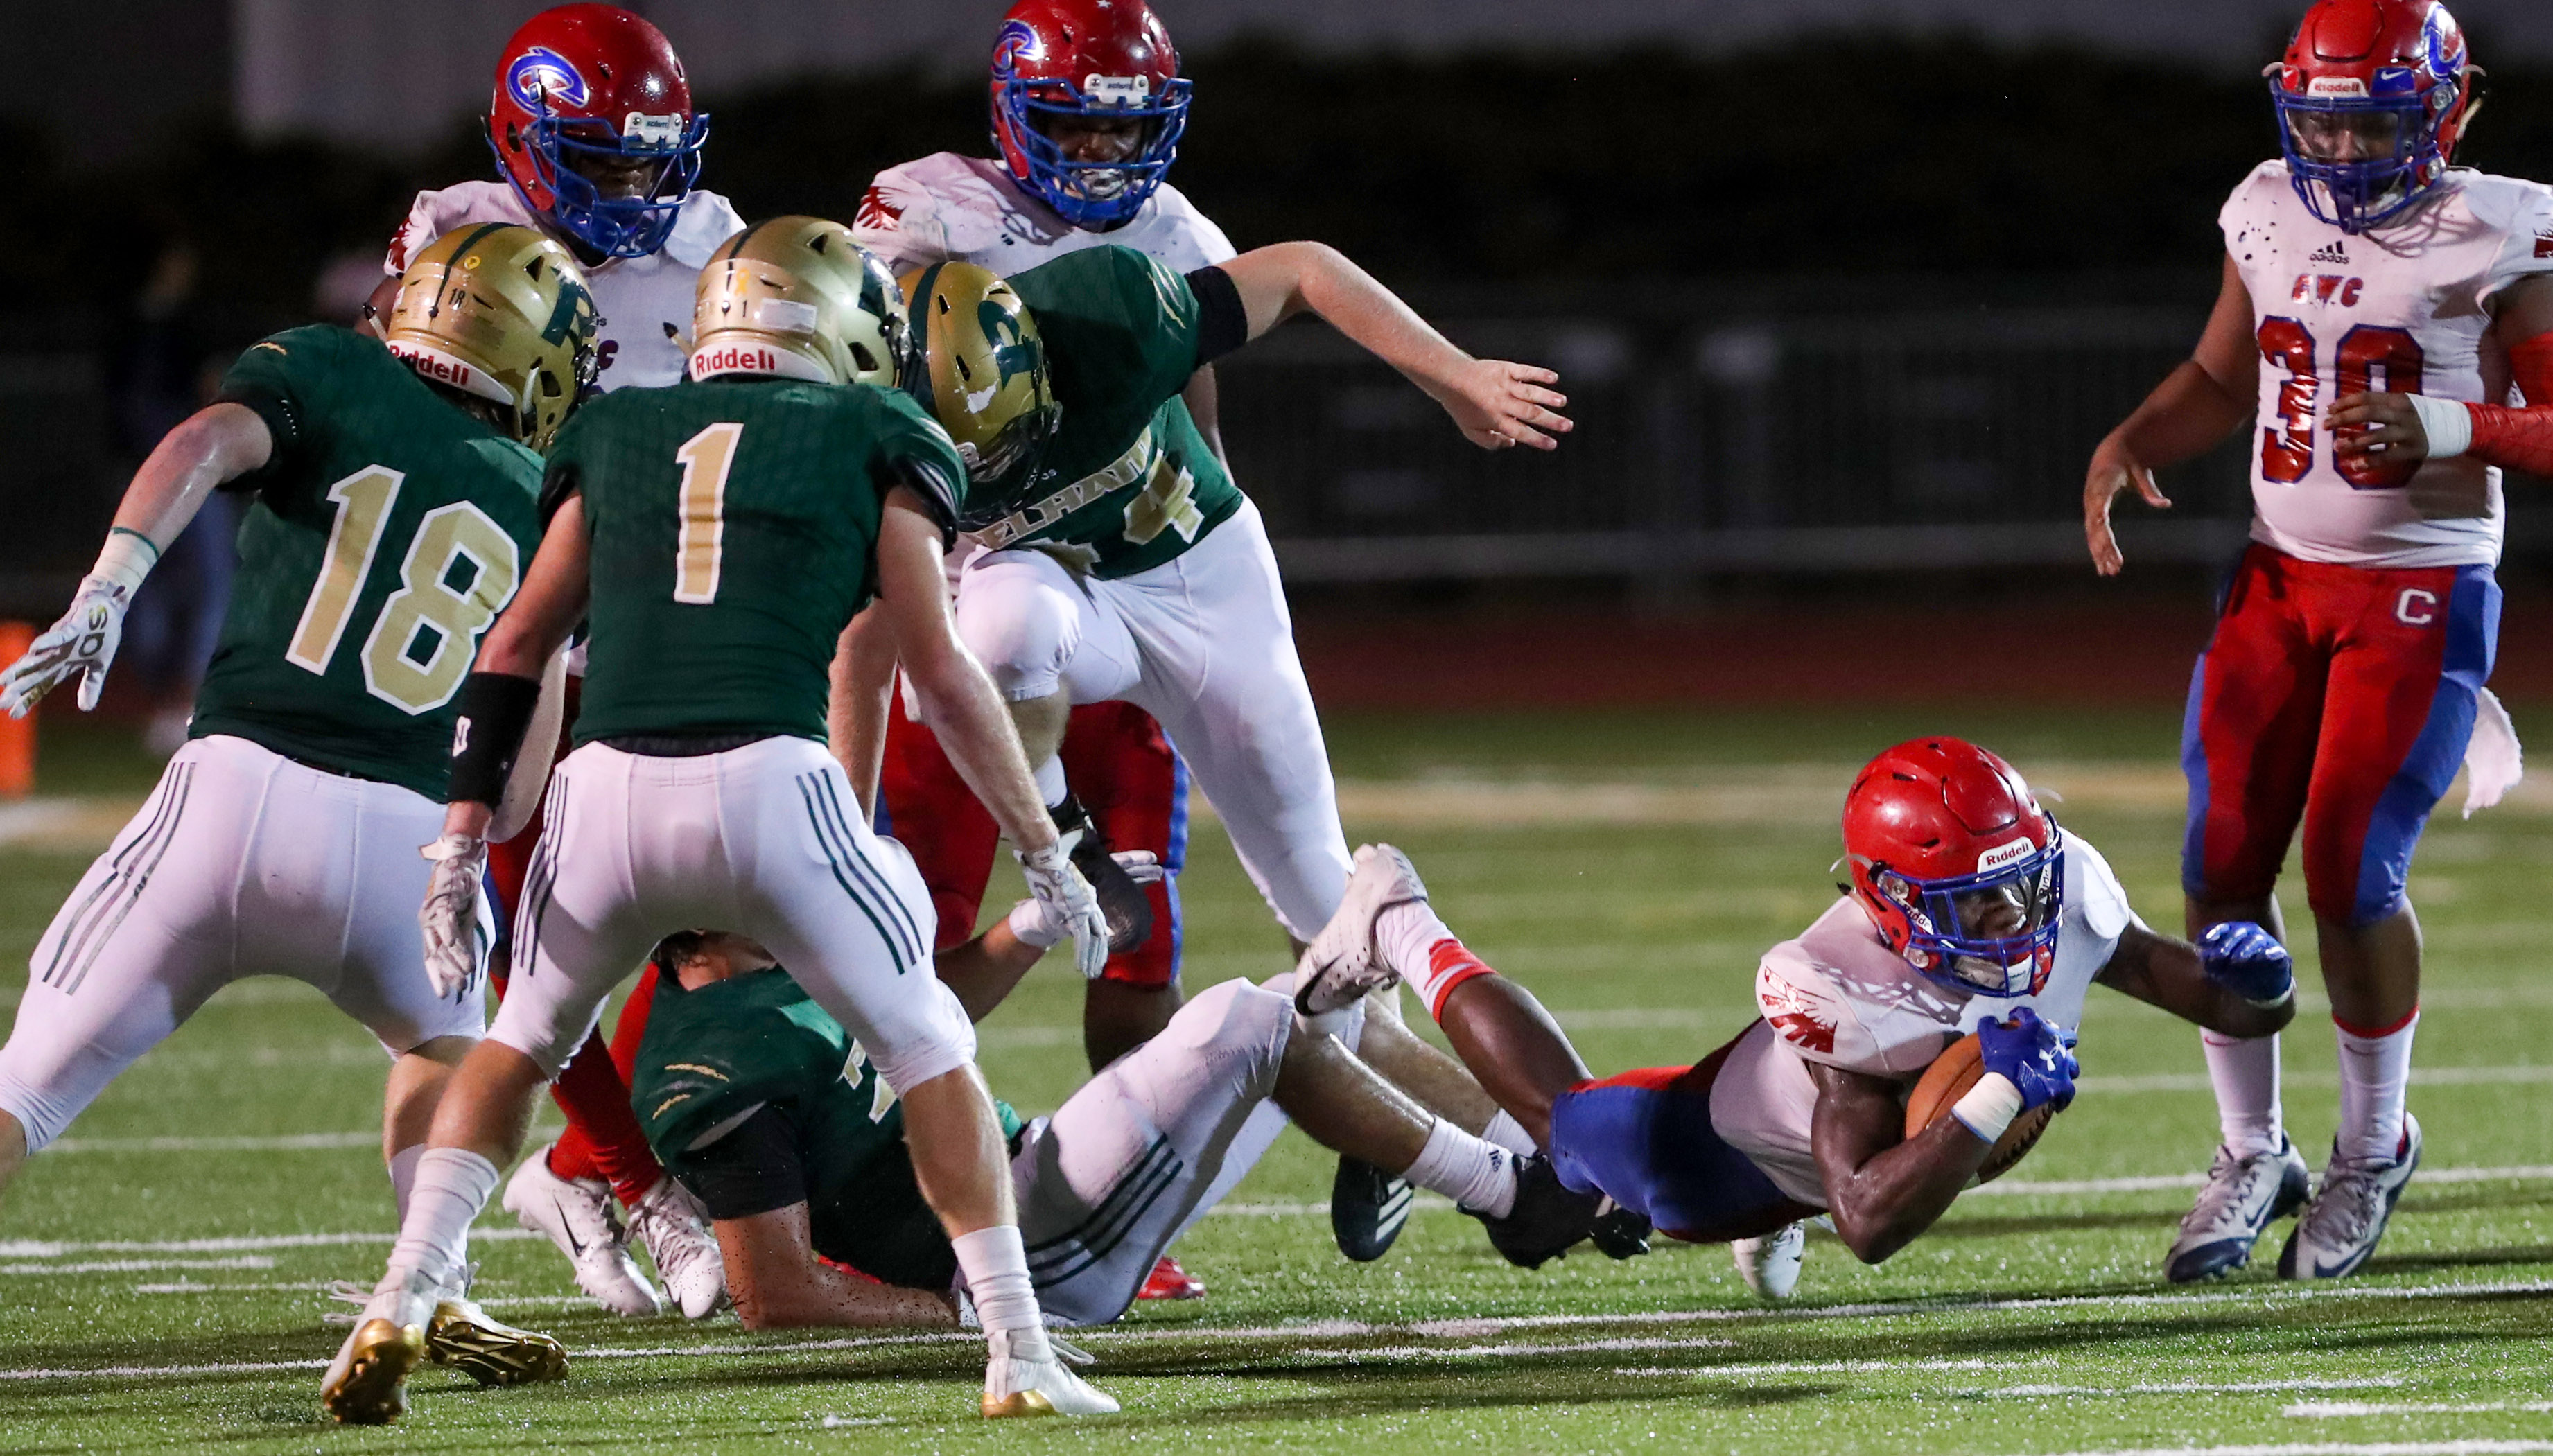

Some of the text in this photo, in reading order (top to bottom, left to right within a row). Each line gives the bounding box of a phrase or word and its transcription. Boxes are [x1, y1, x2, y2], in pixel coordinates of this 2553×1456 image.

[2309, 249, 2350, 264] adidas
[448, 288, 466, 308] 18
[742, 299, 748, 317] 1
[695, 348, 775, 377] Riddell
[2257, 315, 2425, 491] 30
[673, 422, 744, 604] 1
[284, 464, 520, 716] 18
[2396, 588, 2437, 624] C
[1986, 843, 2030, 866] Riddell
